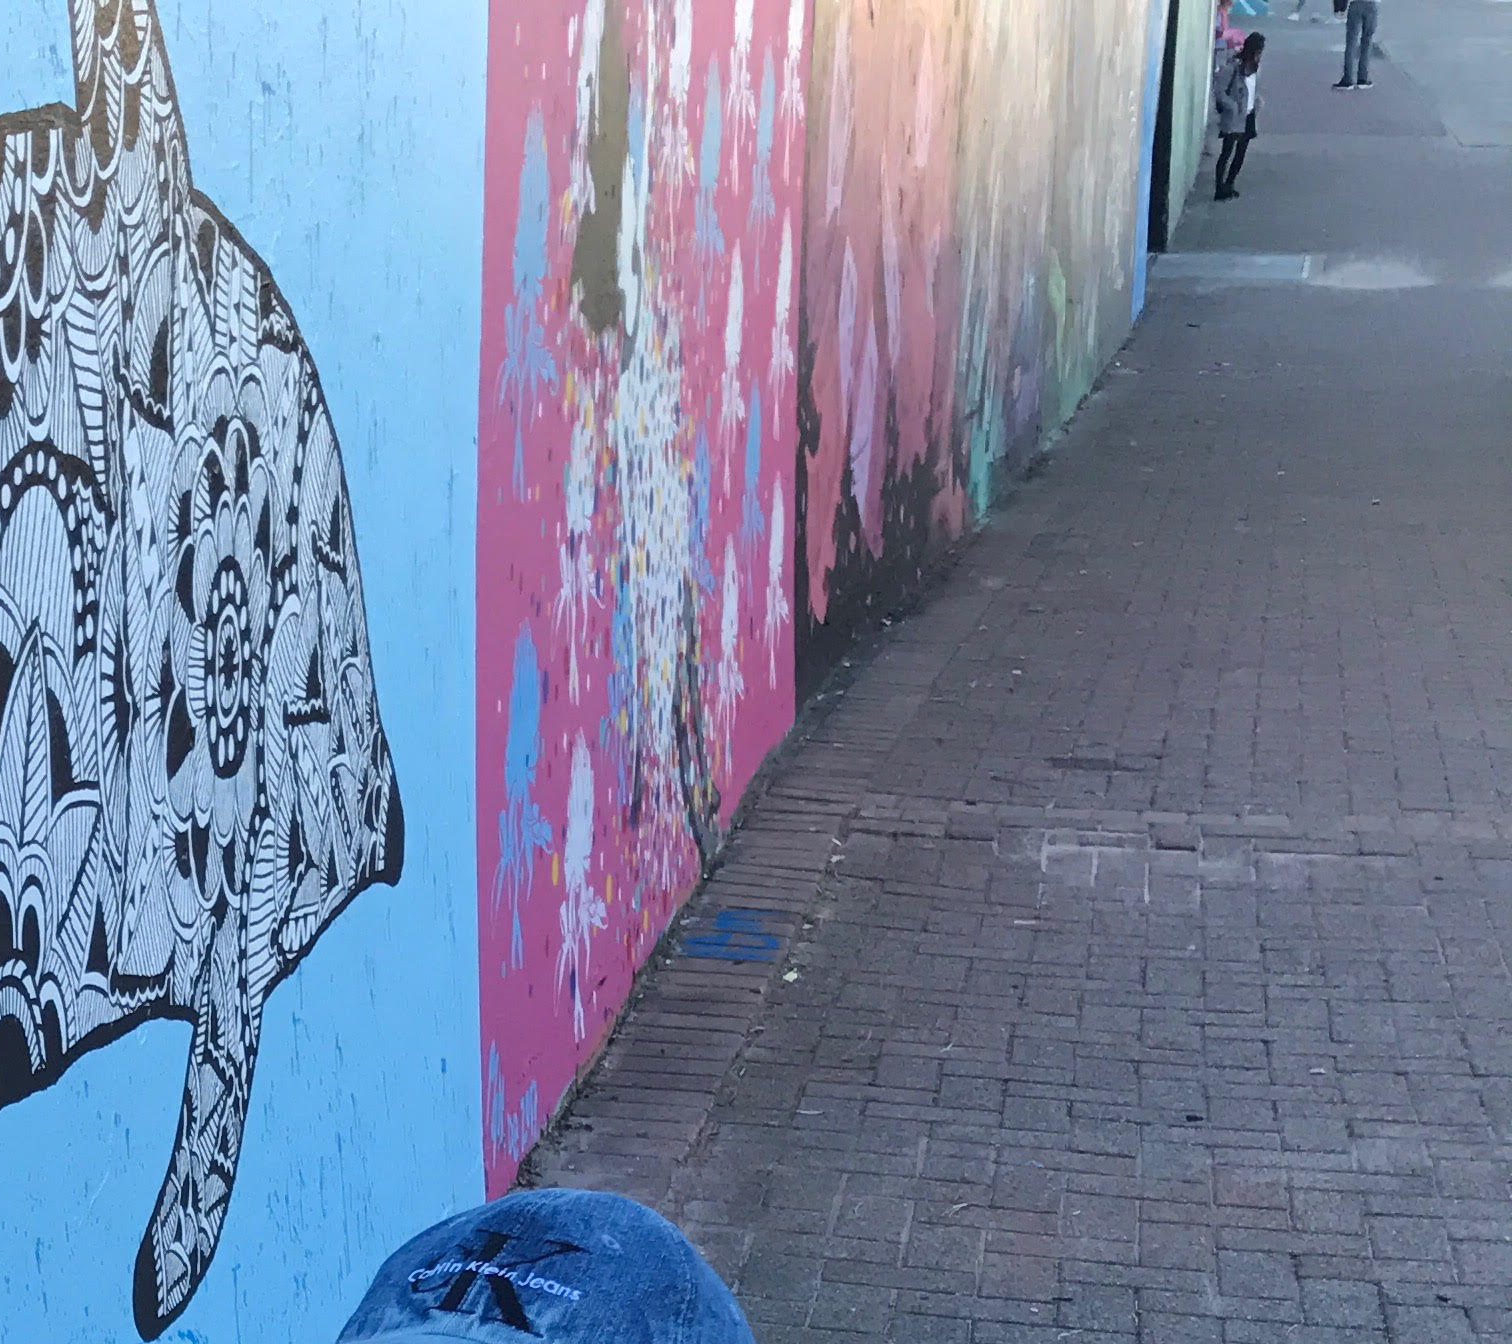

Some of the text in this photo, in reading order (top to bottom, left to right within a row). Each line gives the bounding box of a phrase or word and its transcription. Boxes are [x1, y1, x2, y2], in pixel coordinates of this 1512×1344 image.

[408, 1259, 583, 1301] Calvin Klein Jeans
